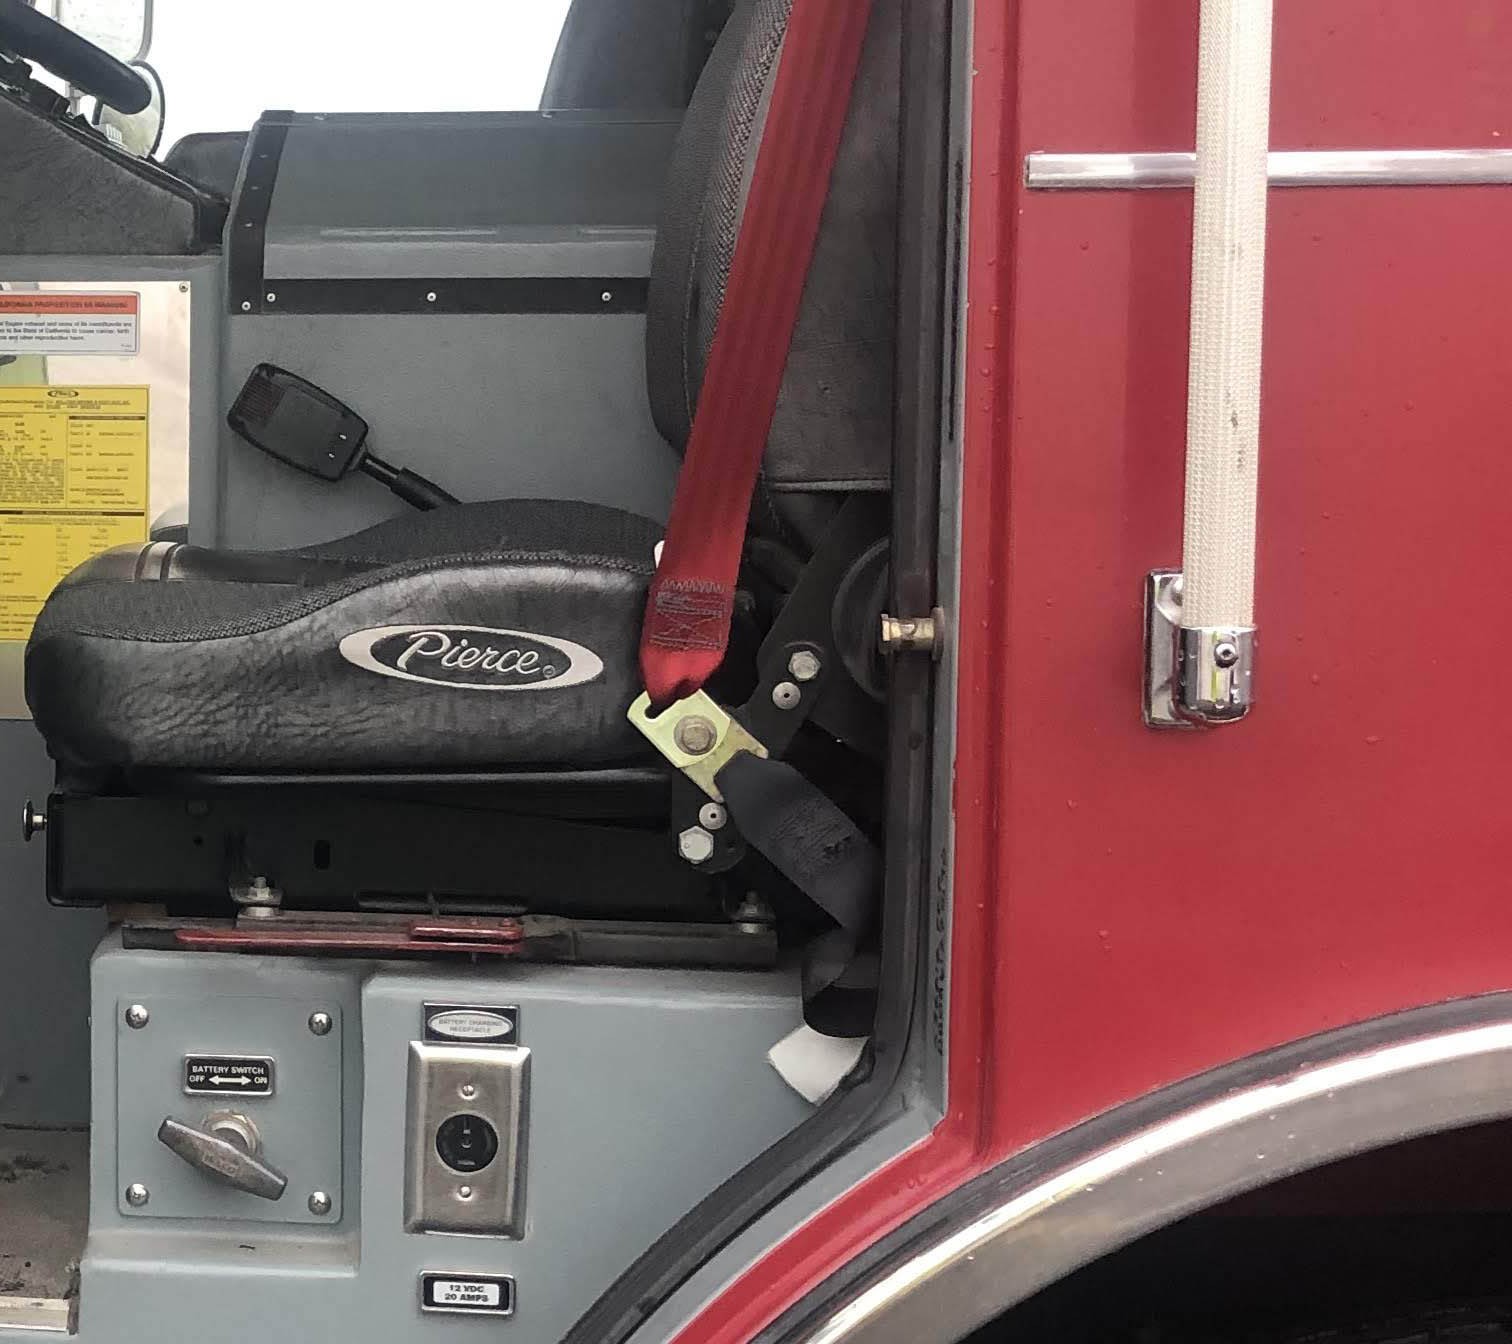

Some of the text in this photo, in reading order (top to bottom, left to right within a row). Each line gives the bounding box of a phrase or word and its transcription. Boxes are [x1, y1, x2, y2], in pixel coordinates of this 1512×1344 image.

[396, 631, 541, 674] Pierce
[192, 1065, 264, 1075] BATTERY SWITCH
[189, 1075, 268, 1084] OFF ON
[449, 1284, 485, 1293] 12 VDC
[444, 1293, 489, 1302] 20 AMPS
